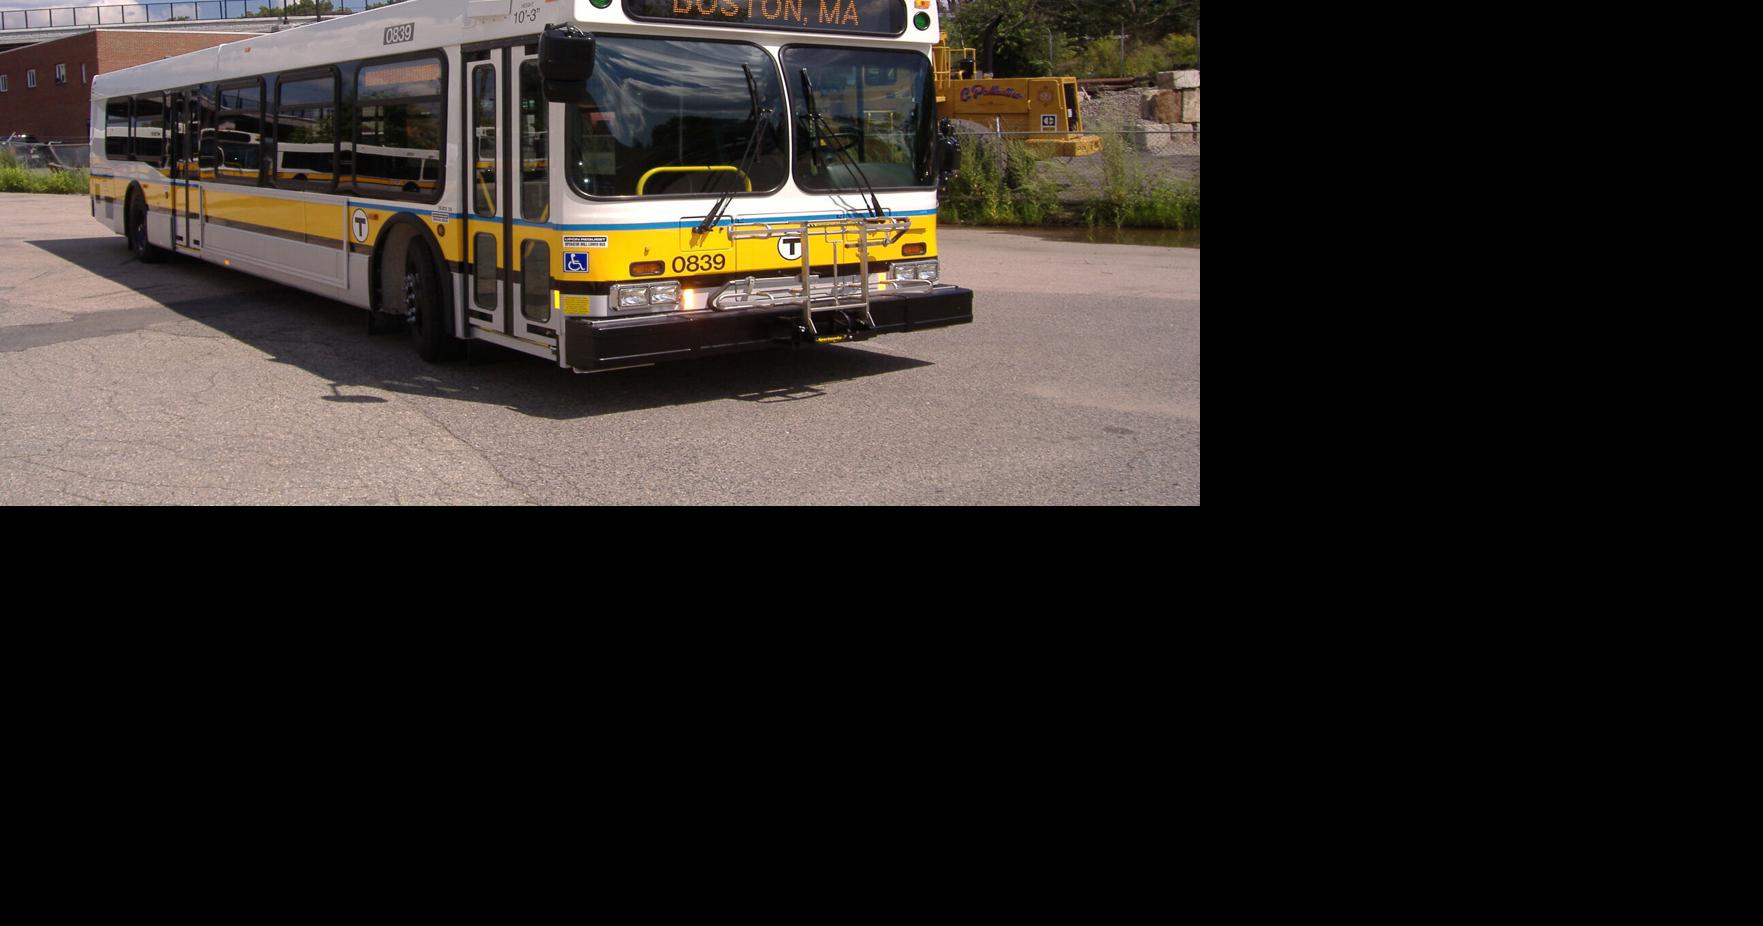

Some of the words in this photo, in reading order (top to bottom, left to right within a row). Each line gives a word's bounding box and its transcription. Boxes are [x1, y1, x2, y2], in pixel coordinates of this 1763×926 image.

[819, 0, 859, 26] MA
[385, 24, 412, 44] 0839
[355, 217, 366, 237] T
[783, 237, 801, 255] T
[672, 253, 726, 273] 0839
